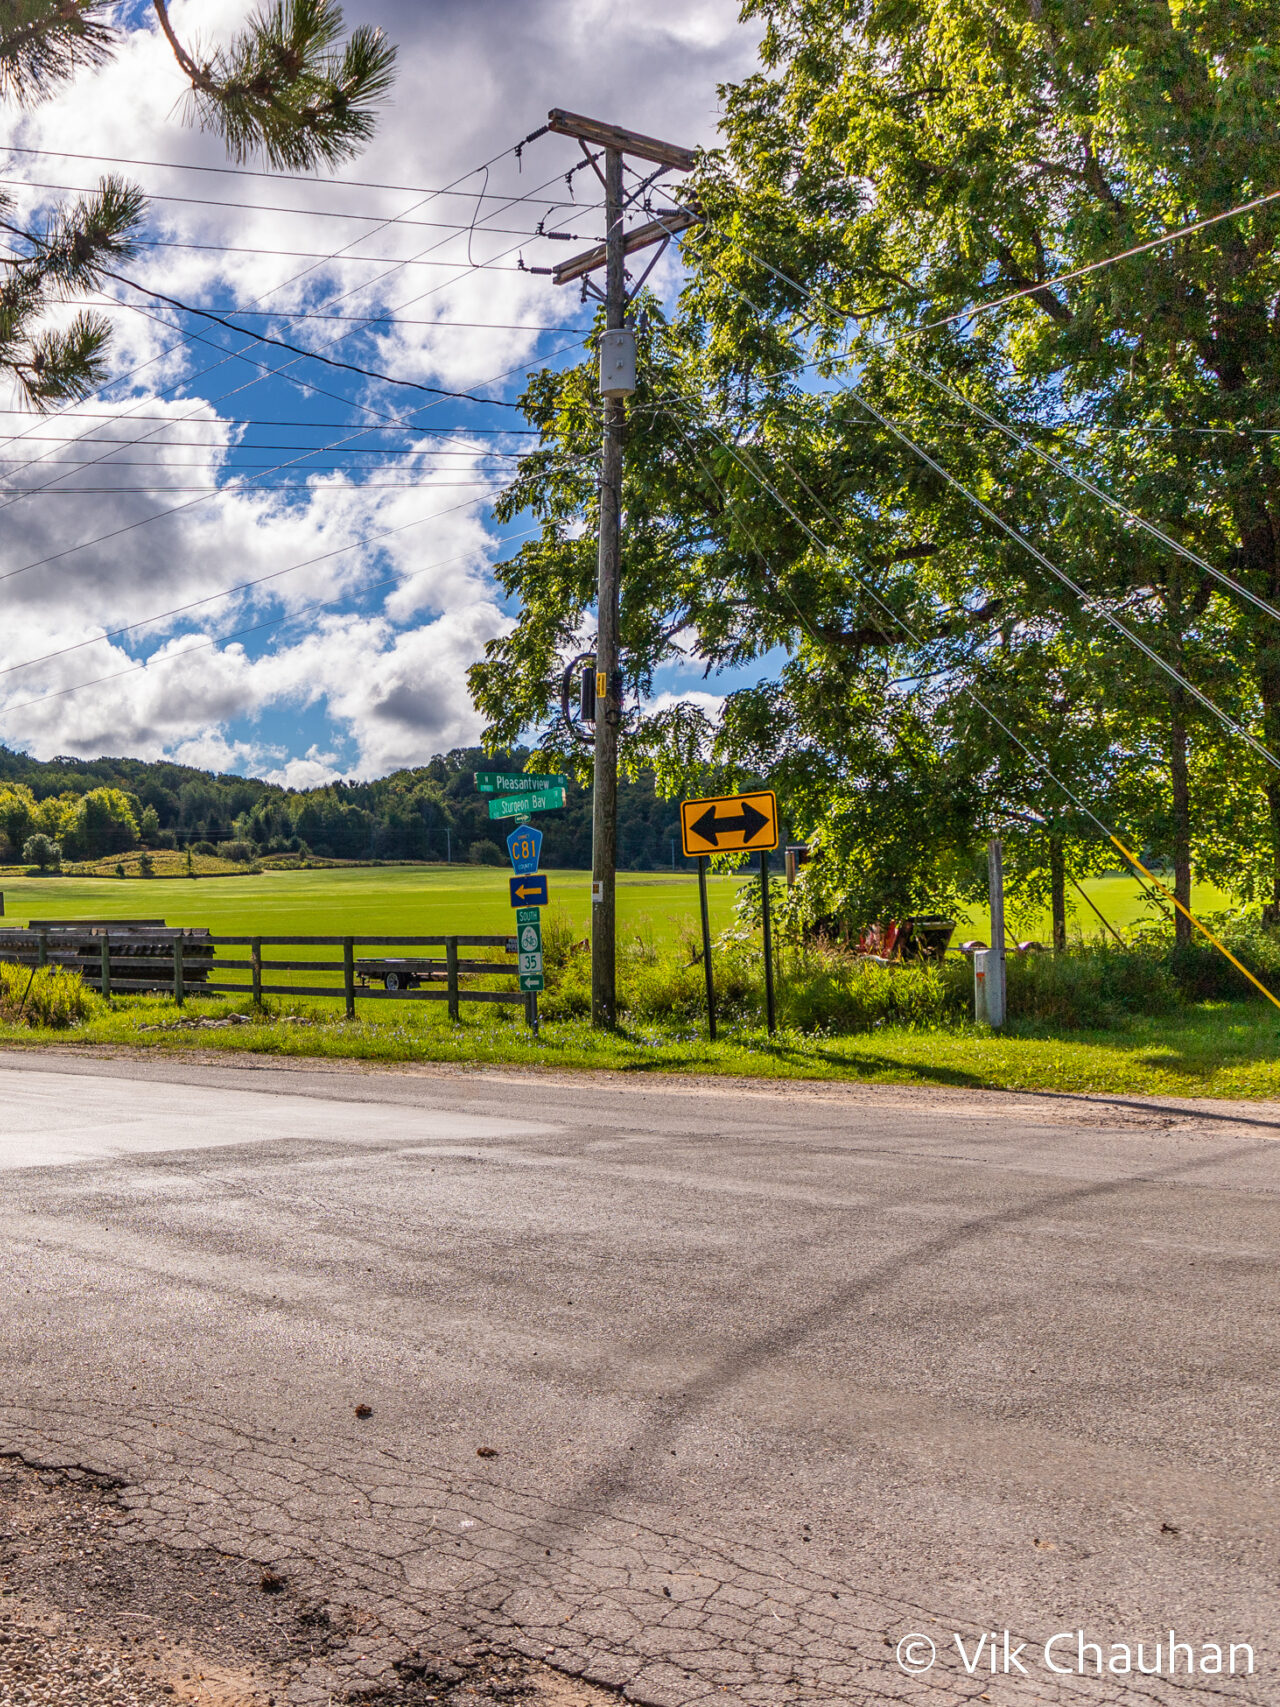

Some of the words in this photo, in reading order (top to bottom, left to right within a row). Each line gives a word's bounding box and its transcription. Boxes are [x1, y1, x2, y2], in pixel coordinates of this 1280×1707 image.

[496, 775, 550, 790] Pleasantview
[501, 799, 530, 814] Sturgeon
[531, 795, 546, 809] Bay
[512, 840, 536, 860] C81
[519, 911, 538, 922] SOUTH
[524, 956, 537, 970] 35
